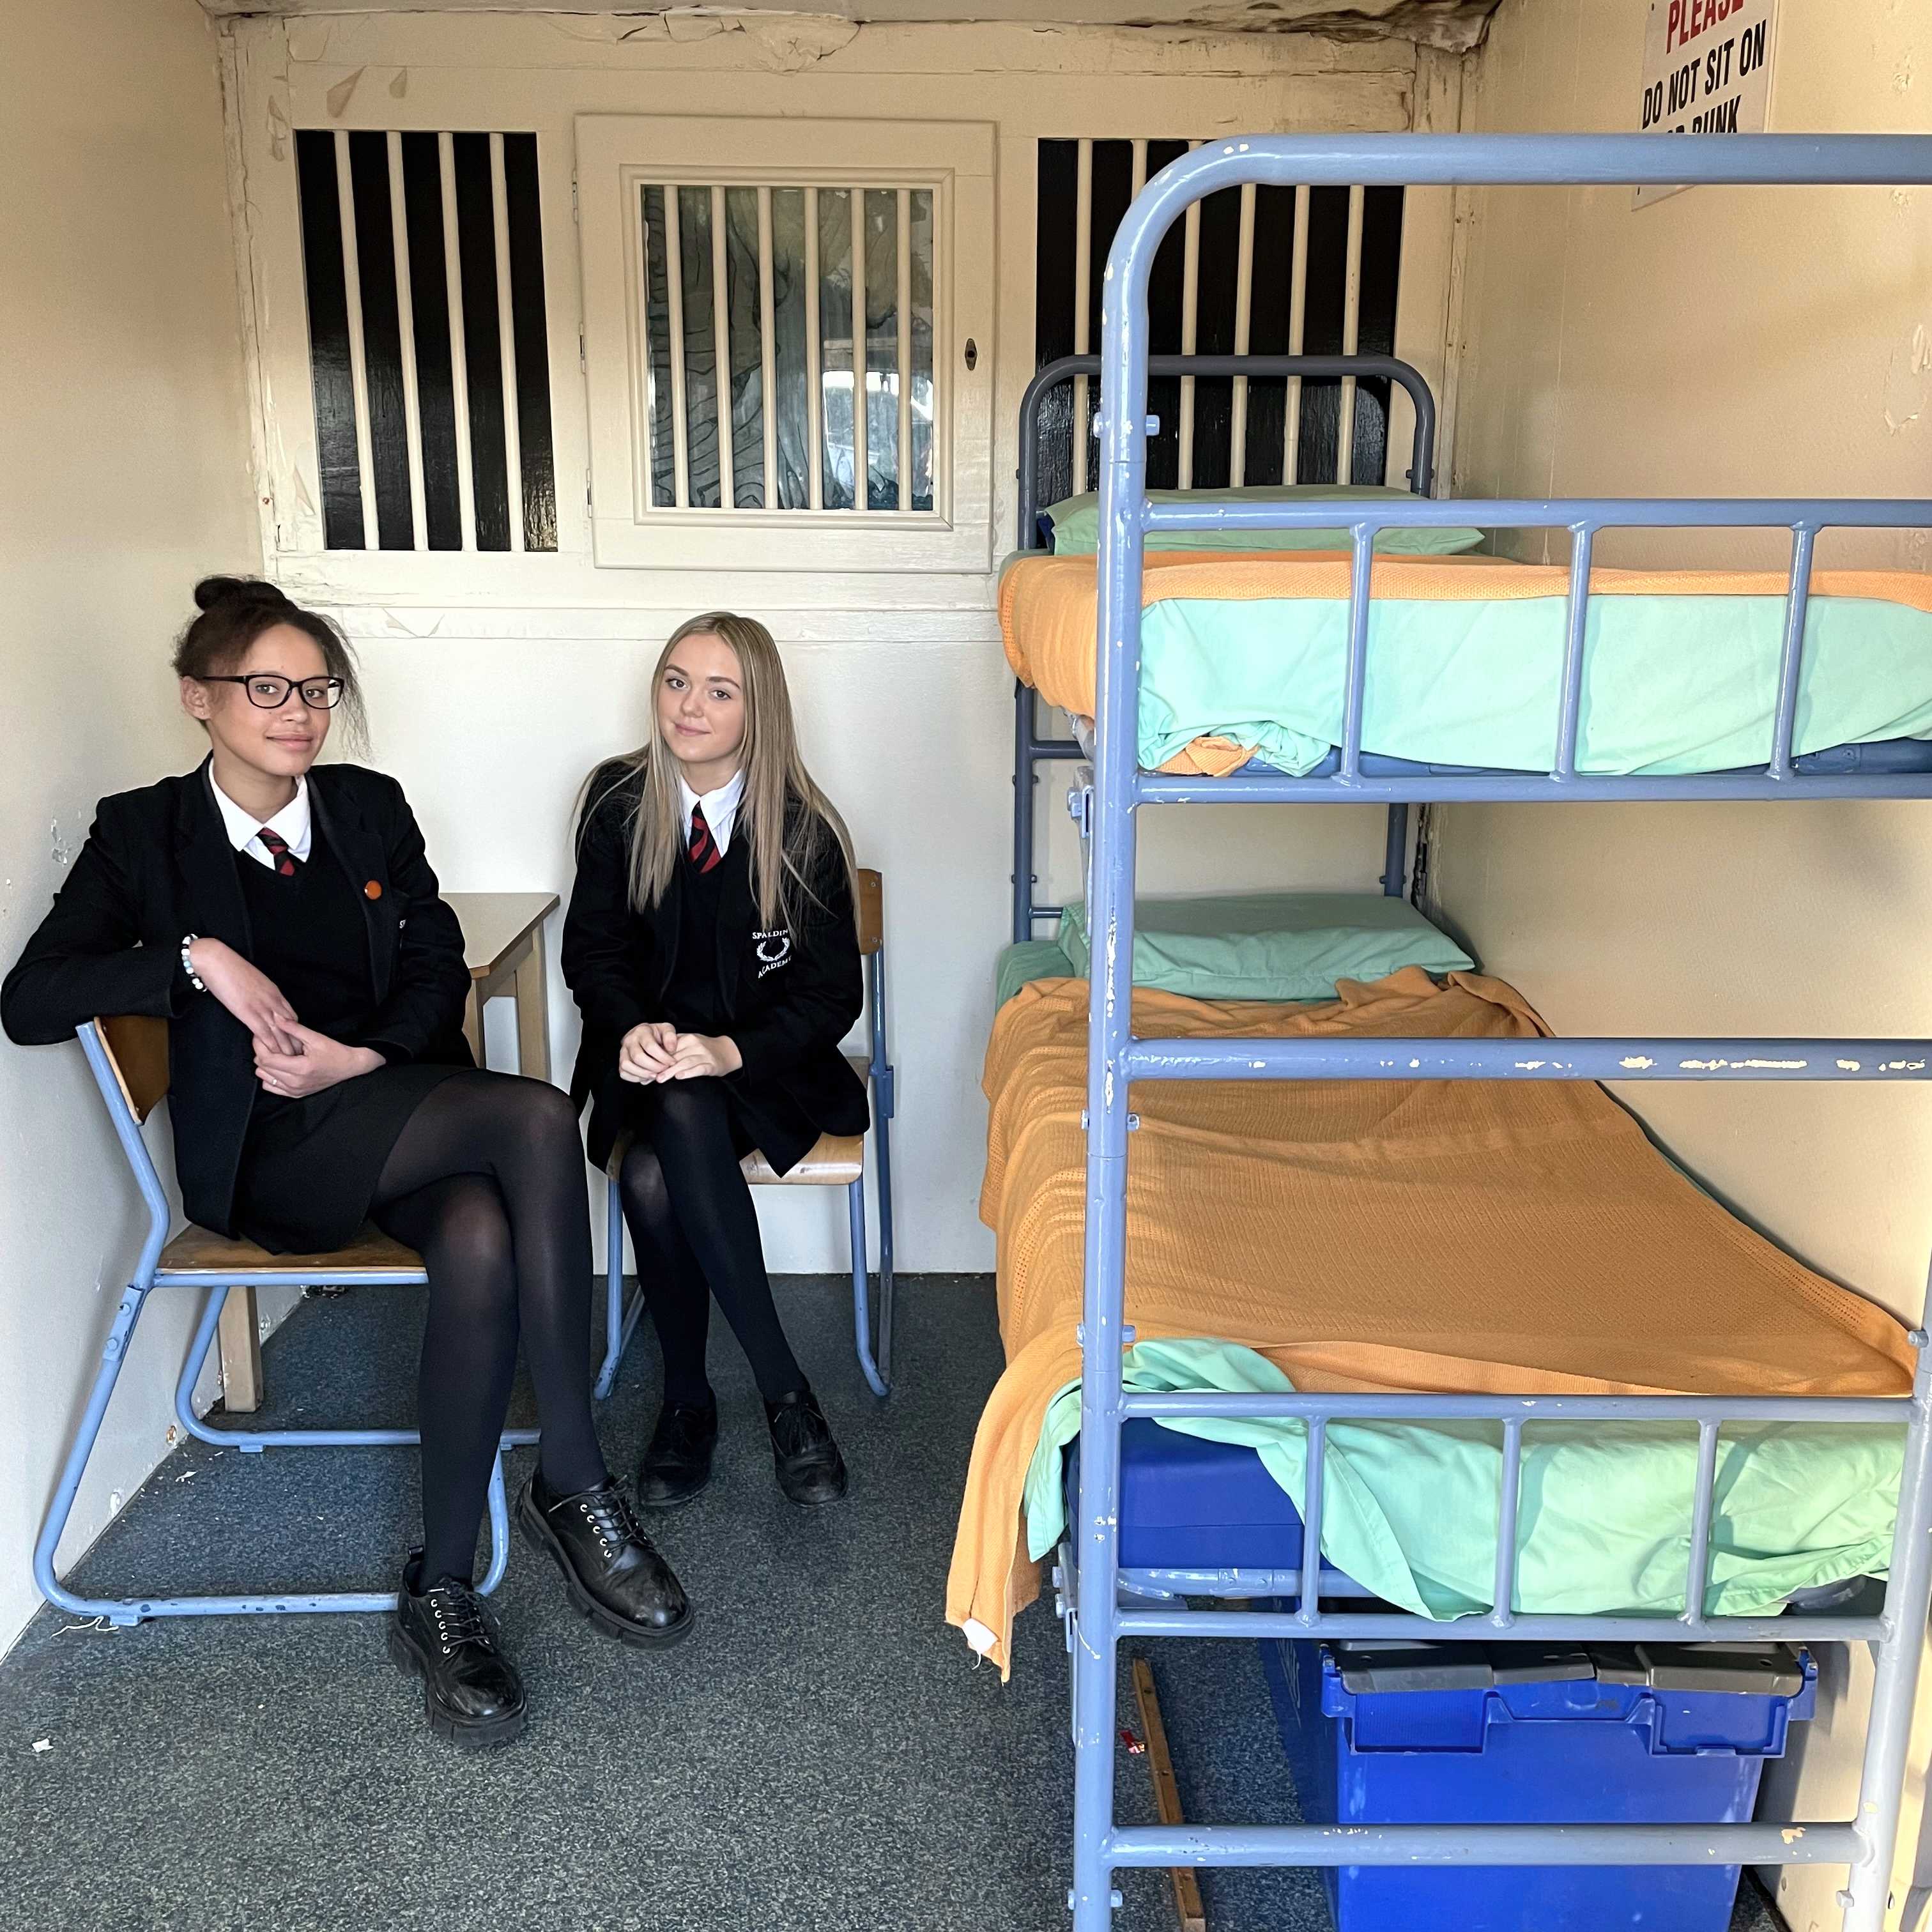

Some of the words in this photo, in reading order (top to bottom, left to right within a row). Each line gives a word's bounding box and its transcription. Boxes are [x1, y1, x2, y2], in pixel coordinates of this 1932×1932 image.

[1666, 0, 1744, 54] PLEA
[1642, 81, 1663, 130] DO
[1667, 57, 1701, 116] NOT
[1705, 38, 1735, 95] SIT
[1739, 19, 1767, 76] ON
[752, 929, 788, 939] SPALDIN
